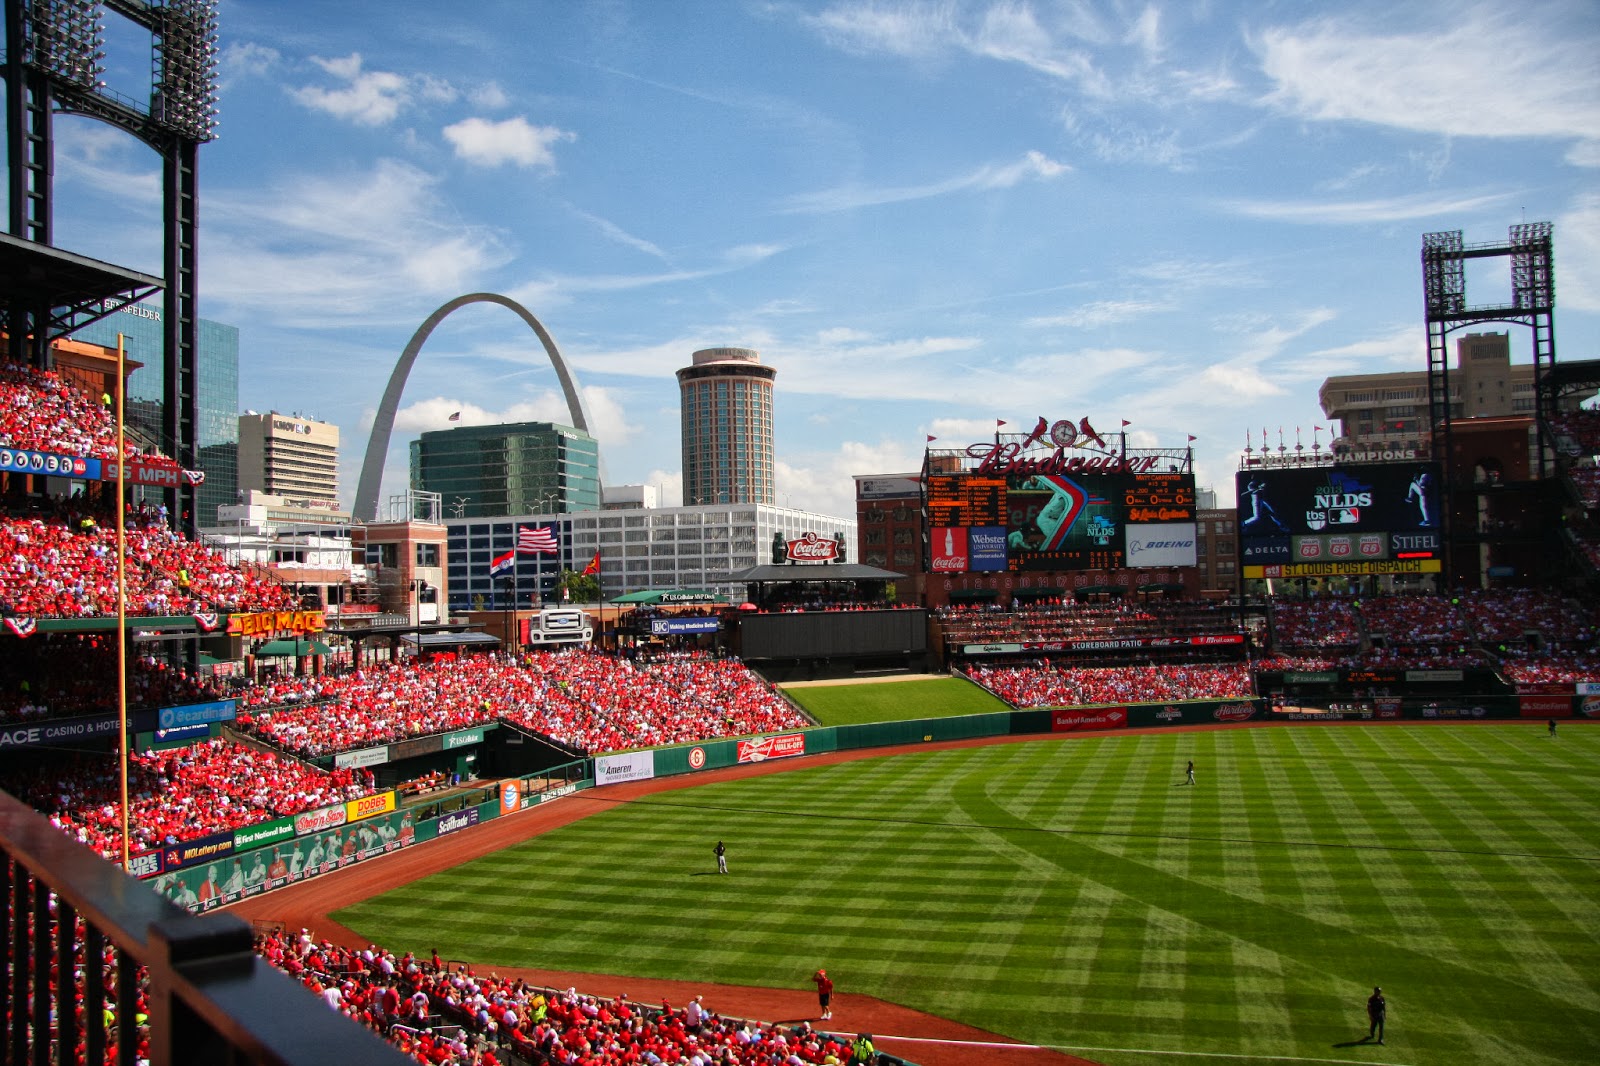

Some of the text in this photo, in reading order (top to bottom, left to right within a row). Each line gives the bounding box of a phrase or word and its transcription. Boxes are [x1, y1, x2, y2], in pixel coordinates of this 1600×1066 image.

[0, 451, 72, 472] POWER
[966, 442, 1158, 474] Budweiser
[1259, 450, 1416, 466] WORLD CHAMPIONS
[138, 467, 178, 484] MPH
[1316, 486, 1342, 494] 2013
[1314, 493, 1372, 509] NLDS
[1306, 511, 1325, 520] tbs
[1087, 528, 1114, 536] NLDS
[972, 535, 1005, 544] Webster
[1392, 535, 1439, 550] STIFEL
[793, 542, 832, 557] Coca-Cola
[1302, 546, 1317, 554] 66
[1332, 545, 1346, 553] 66
[1363, 544, 1377, 552] 66
[932, 556, 966, 569] Coca-Cola
[1285, 564, 1300, 575] ST.
[1302, 563, 1332, 574] LOUIS
[1336, 560, 1421, 574] POST-DISPATCH
[1020, 578, 1030, 587] 10
[1038, 578, 1048, 587] 14
[1056, 577, 1067, 587] 17
[1075, 576, 1088, 586] 20
[1095, 576, 1108, 585] 24
[1117, 575, 1129, 585] 42
[240, 611, 316, 634] BIG MAC
[654, 623, 667, 632] BJC
[1072, 641, 1119, 649] SCOREBOARD
[1121, 640, 1142, 648] PATIO
[176, 706, 233, 723] @cardinals
[1080, 716, 1106, 724] America
[46, 725, 84, 738] CASINO
[87, 724, 94, 732] &
[96, 719, 132, 732] HOTES
[774, 741, 804, 751] WALK-OFF
[694, 752, 700, 764] 6
[606, 765, 632, 775] Ameren
[541, 784, 576, 802] BUSCH STADIUM
[358, 796, 386, 812] DOBBS
[297, 816, 317, 831] Shop
[325, 810, 344, 823] Save
[439, 813, 468, 834] Scottrade
[242, 825, 293, 843] First National Bank
[184, 841, 232, 859] MOLottery.com
[304, 866, 311, 878] 17
[264, 878, 272, 890] 10
